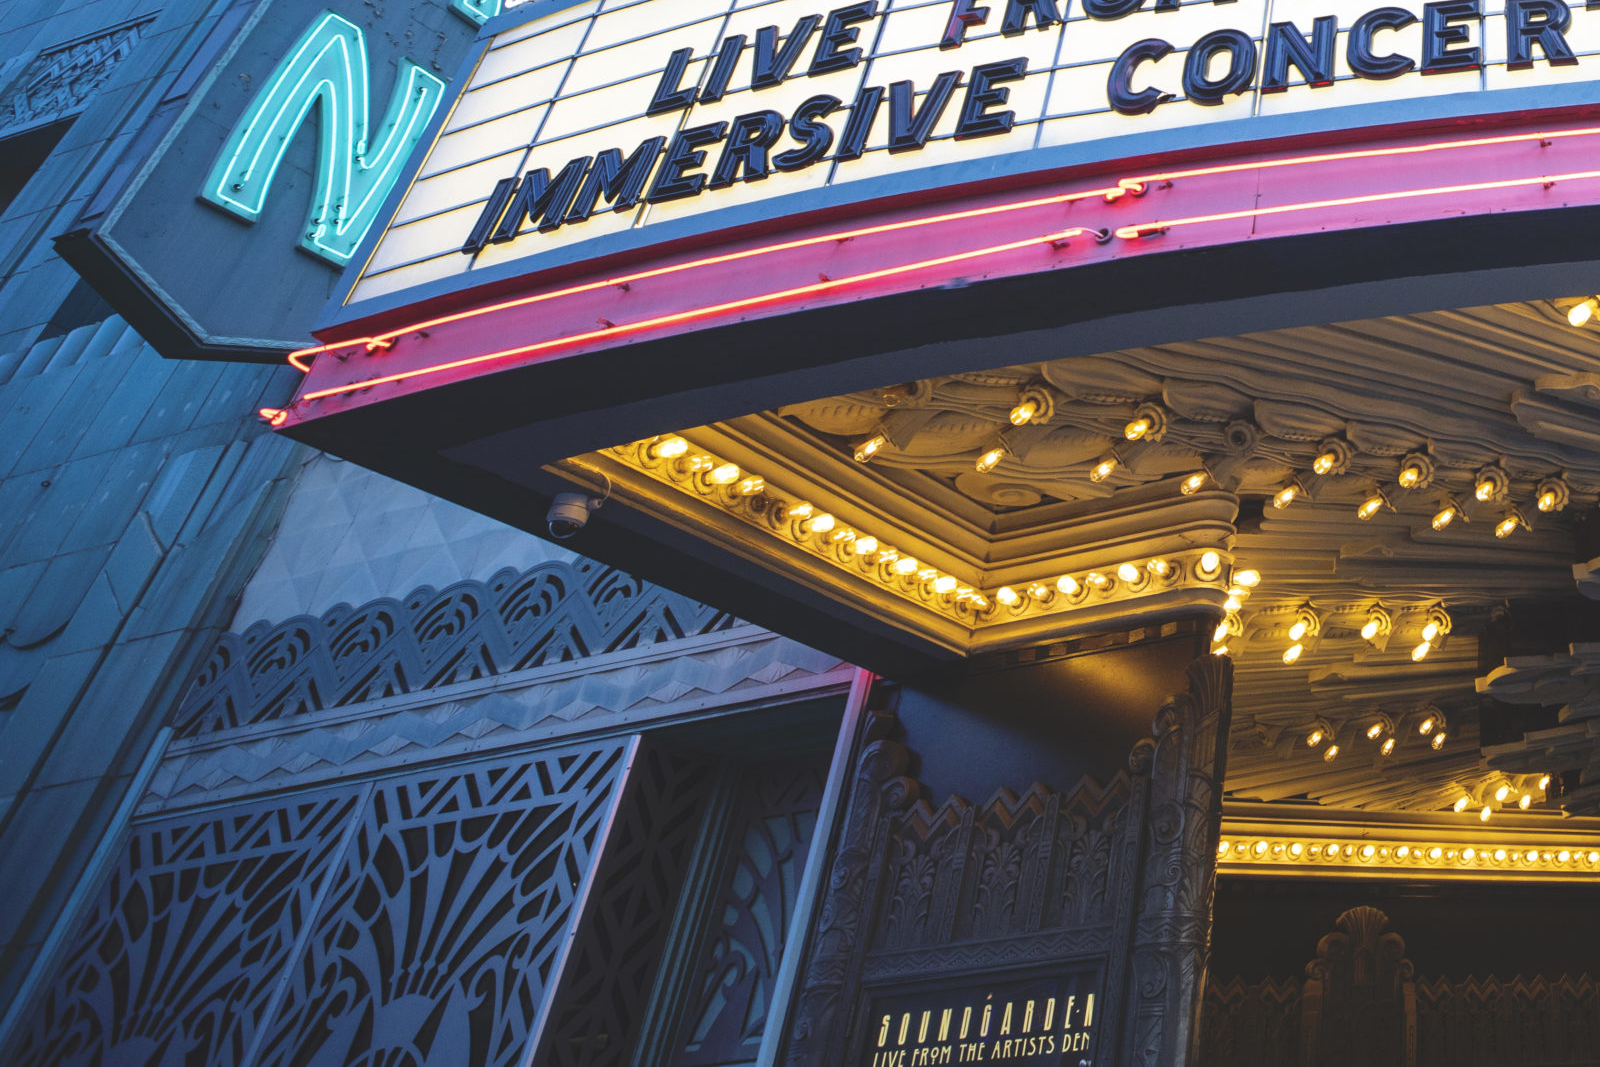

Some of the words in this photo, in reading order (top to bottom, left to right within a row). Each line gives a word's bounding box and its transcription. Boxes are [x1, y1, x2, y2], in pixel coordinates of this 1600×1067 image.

[463, 56, 1029, 255] IMMERSIVE
[877, 992, 1096, 1048] SOUNDGARDEN
[872, 1049, 907, 1067] LIVE
[911, 1044, 953, 1067] FROM
[959, 1041, 986, 1063] THE
[991, 1034, 1056, 1059] ARTISTS
[1061, 1031, 1091, 1053] DEN
